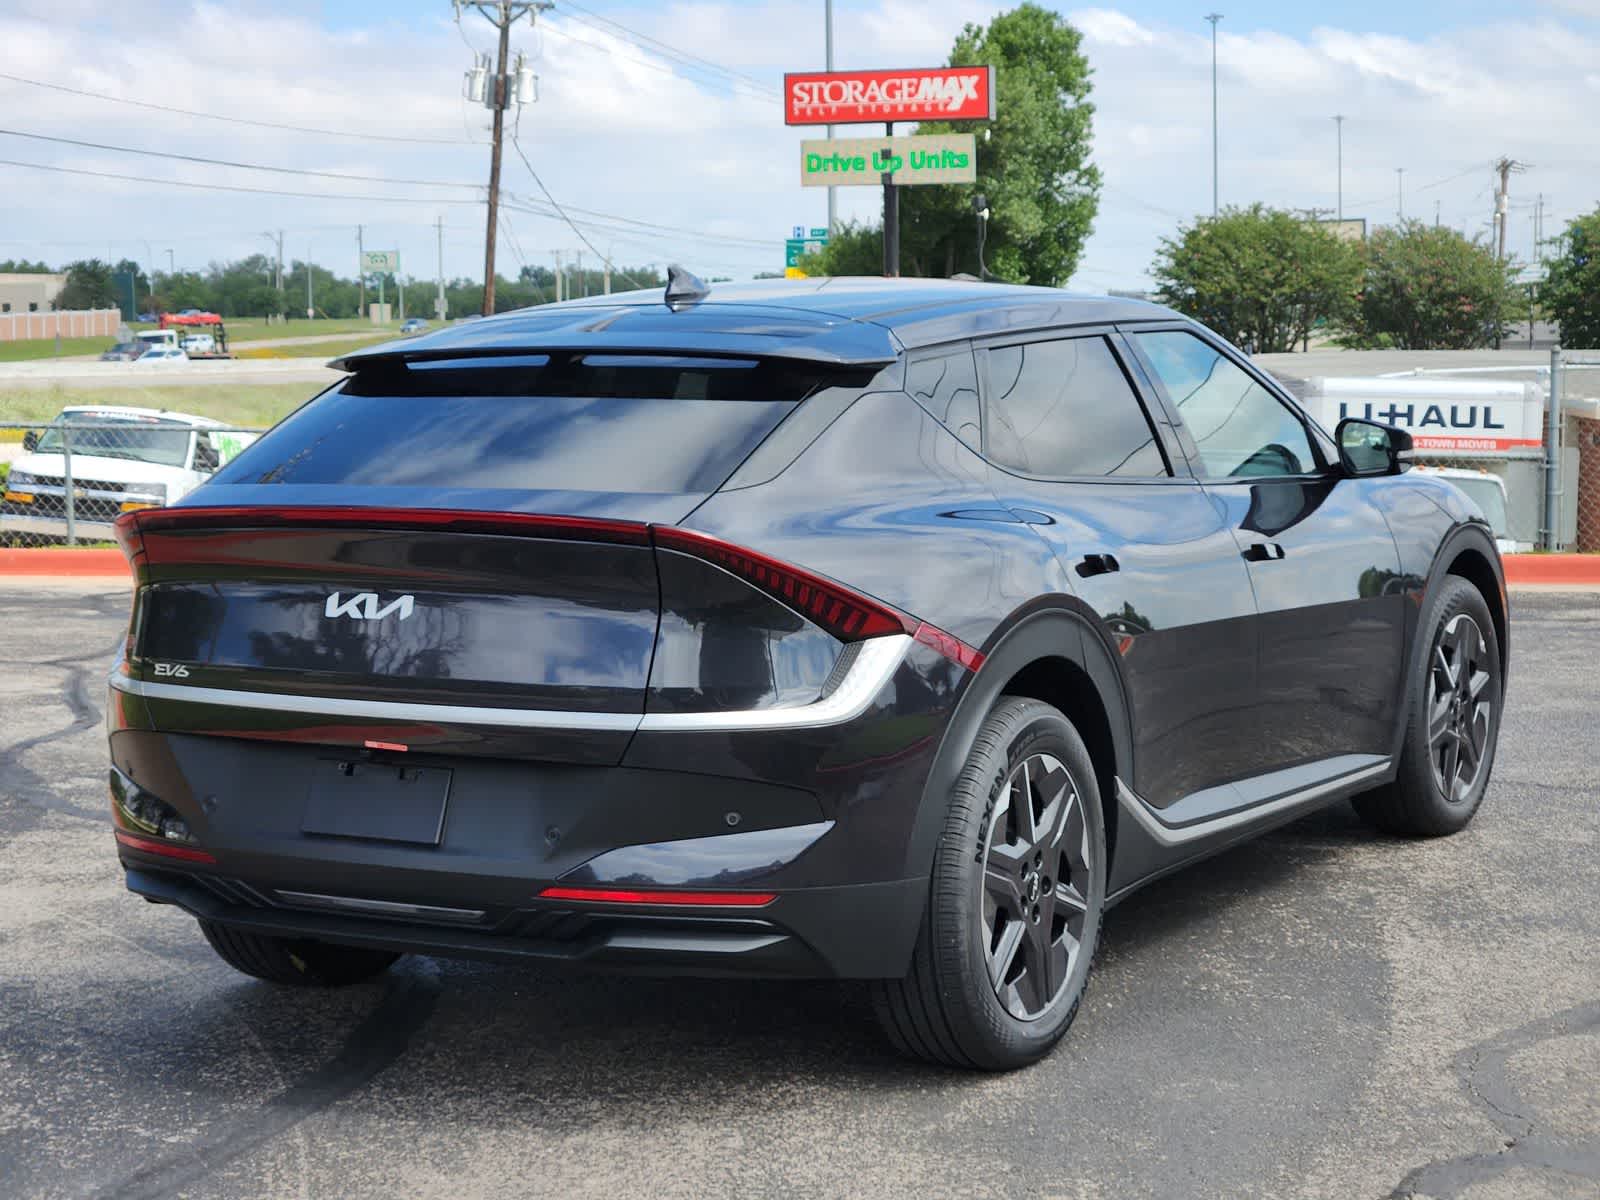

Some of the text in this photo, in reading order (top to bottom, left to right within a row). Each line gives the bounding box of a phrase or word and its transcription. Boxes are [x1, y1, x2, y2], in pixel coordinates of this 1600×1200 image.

[806, 149, 969, 174] Drive Up Units
[1458, 439, 1497, 450] MOVES
[325, 592, 414, 620] KIA
[153, 663, 190, 678] EV6
[974, 767, 1005, 864] NEXEN
